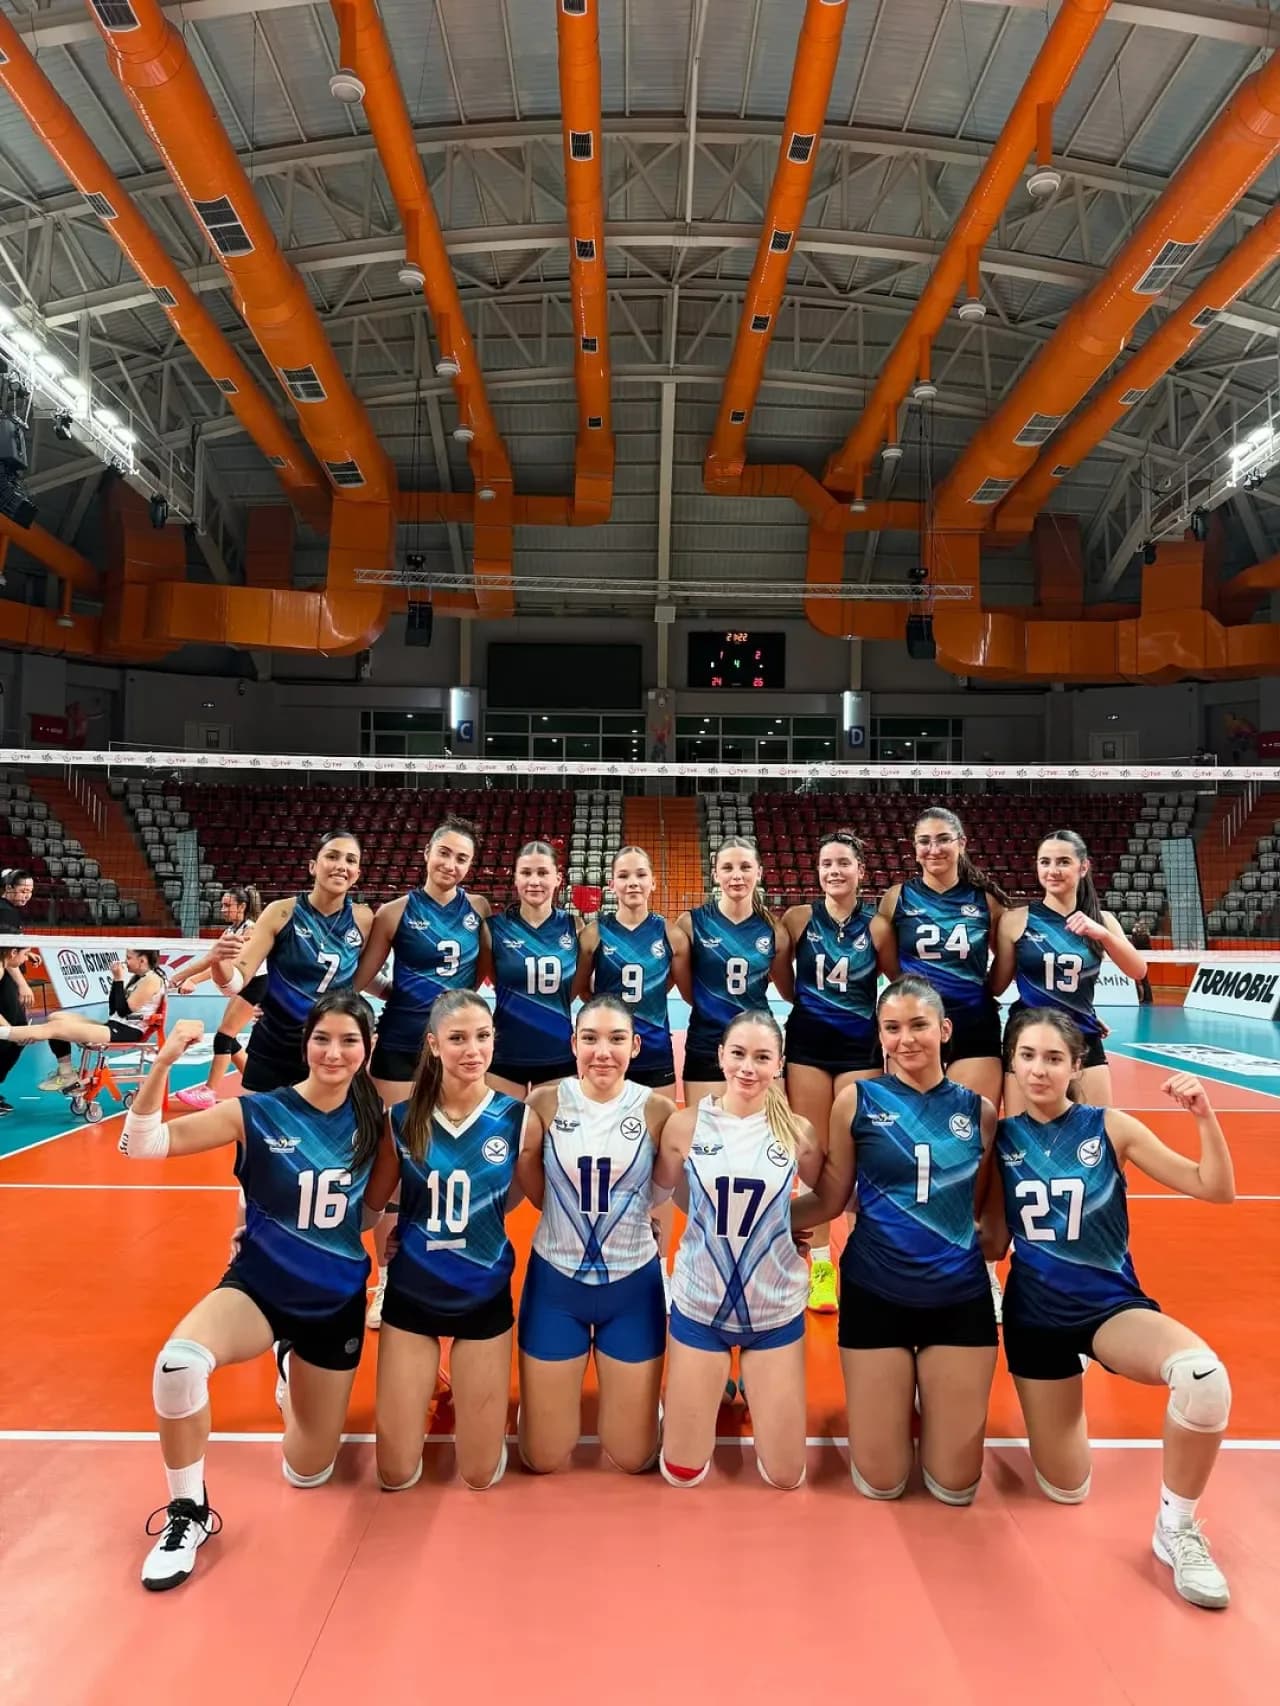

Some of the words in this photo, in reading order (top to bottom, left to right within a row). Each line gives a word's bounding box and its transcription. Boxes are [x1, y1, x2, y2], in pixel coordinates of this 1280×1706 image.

[734, 659, 740, 668] 4
[755, 650, 761, 660] 2
[460, 723, 470, 739] C
[852, 728, 863, 745] D
[435, 939, 461, 977] 3
[915, 923, 971, 961] 24
[315, 952, 343, 994] 7
[621, 963, 645, 1003] 9
[725, 957, 749, 996] 8
[815, 953, 849, 995] 14
[1042, 953, 1084, 994] 13
[577, 1155, 611, 1214] 11
[914, 1143, 931, 1204] 1
[296, 1168, 353, 1231] 16
[426, 1169, 471, 1234] 10
[714, 1175, 766, 1238] 17
[1014, 1178, 1086, 1242] 27
